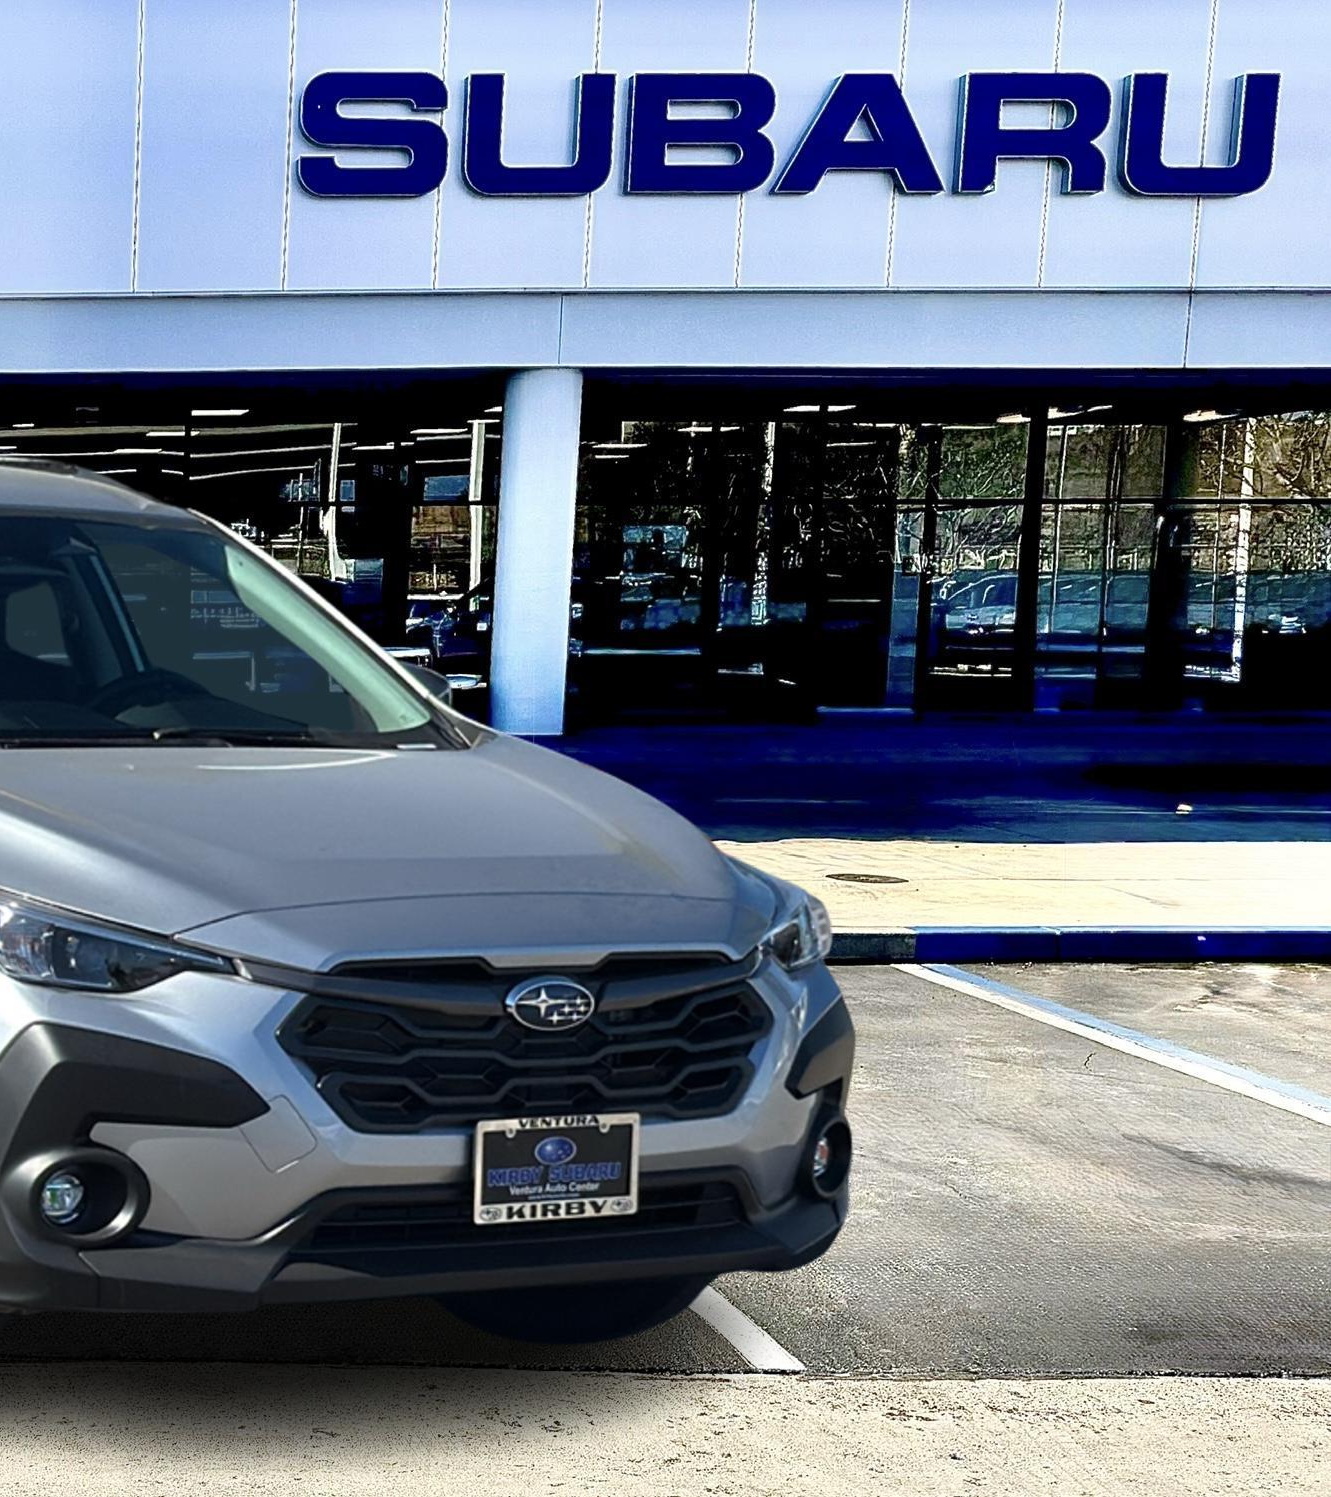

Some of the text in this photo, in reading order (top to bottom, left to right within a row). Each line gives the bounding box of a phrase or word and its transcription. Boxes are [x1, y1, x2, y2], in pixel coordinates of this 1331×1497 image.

[294, 70, 1279, 201] SUBARU
[518, 1115, 600, 1128] VENTURA
[487, 1161, 622, 1187] KIRBY SUBARU
[509, 1180, 600, 1196] Ventura Auto Center
[506, 1199, 608, 1220] KIRBY
